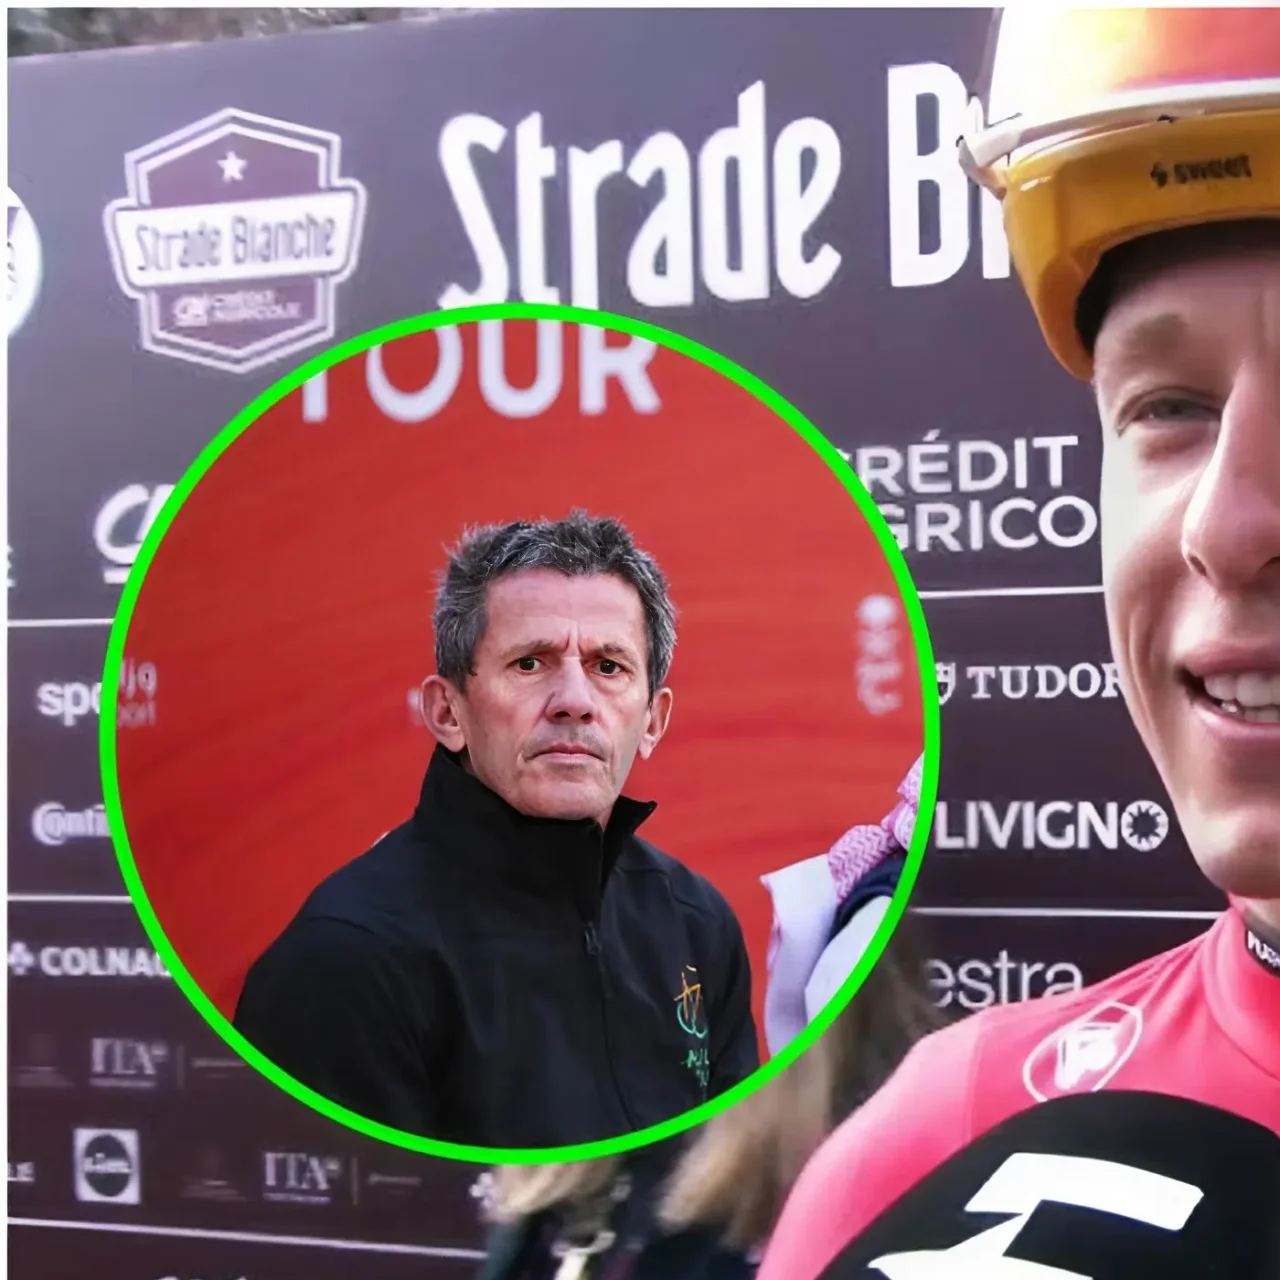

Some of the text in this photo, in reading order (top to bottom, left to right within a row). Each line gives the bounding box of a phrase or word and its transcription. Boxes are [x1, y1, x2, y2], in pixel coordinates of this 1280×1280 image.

[437, 80, 842, 310] Strade
[232, 211, 337, 265] Bianche
[838, 429, 1079, 497] RÉDIT
[934, 800, 1170, 852] LIVIGNO
